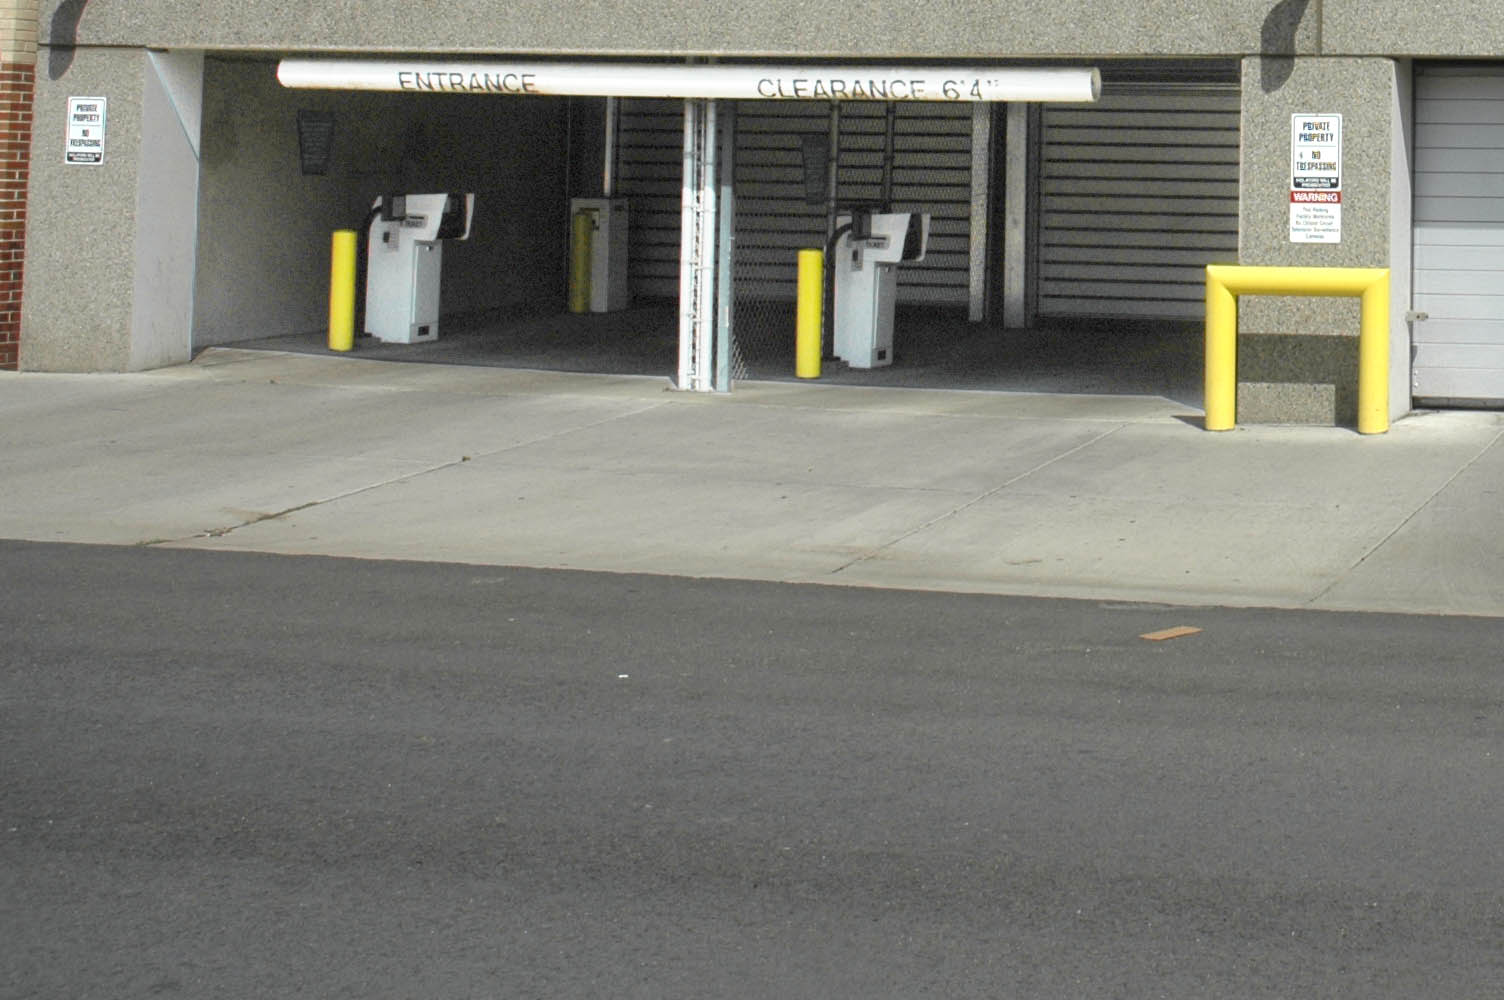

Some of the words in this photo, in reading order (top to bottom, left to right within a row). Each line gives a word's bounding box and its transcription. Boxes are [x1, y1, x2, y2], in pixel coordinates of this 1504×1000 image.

[398, 71, 539, 94] ENTRANCE
[757, 78, 926, 99] CLEARANCE
[73, 113, 100, 122] PROPERTY
[1302, 121, 1330, 131] PRIVATE
[1298, 132, 1334, 142] PROPERTY
[1311, 150, 1321, 160] NO
[1296, 161, 1337, 171] TRESPASSING
[1293, 192, 1339, 202] WARNING
